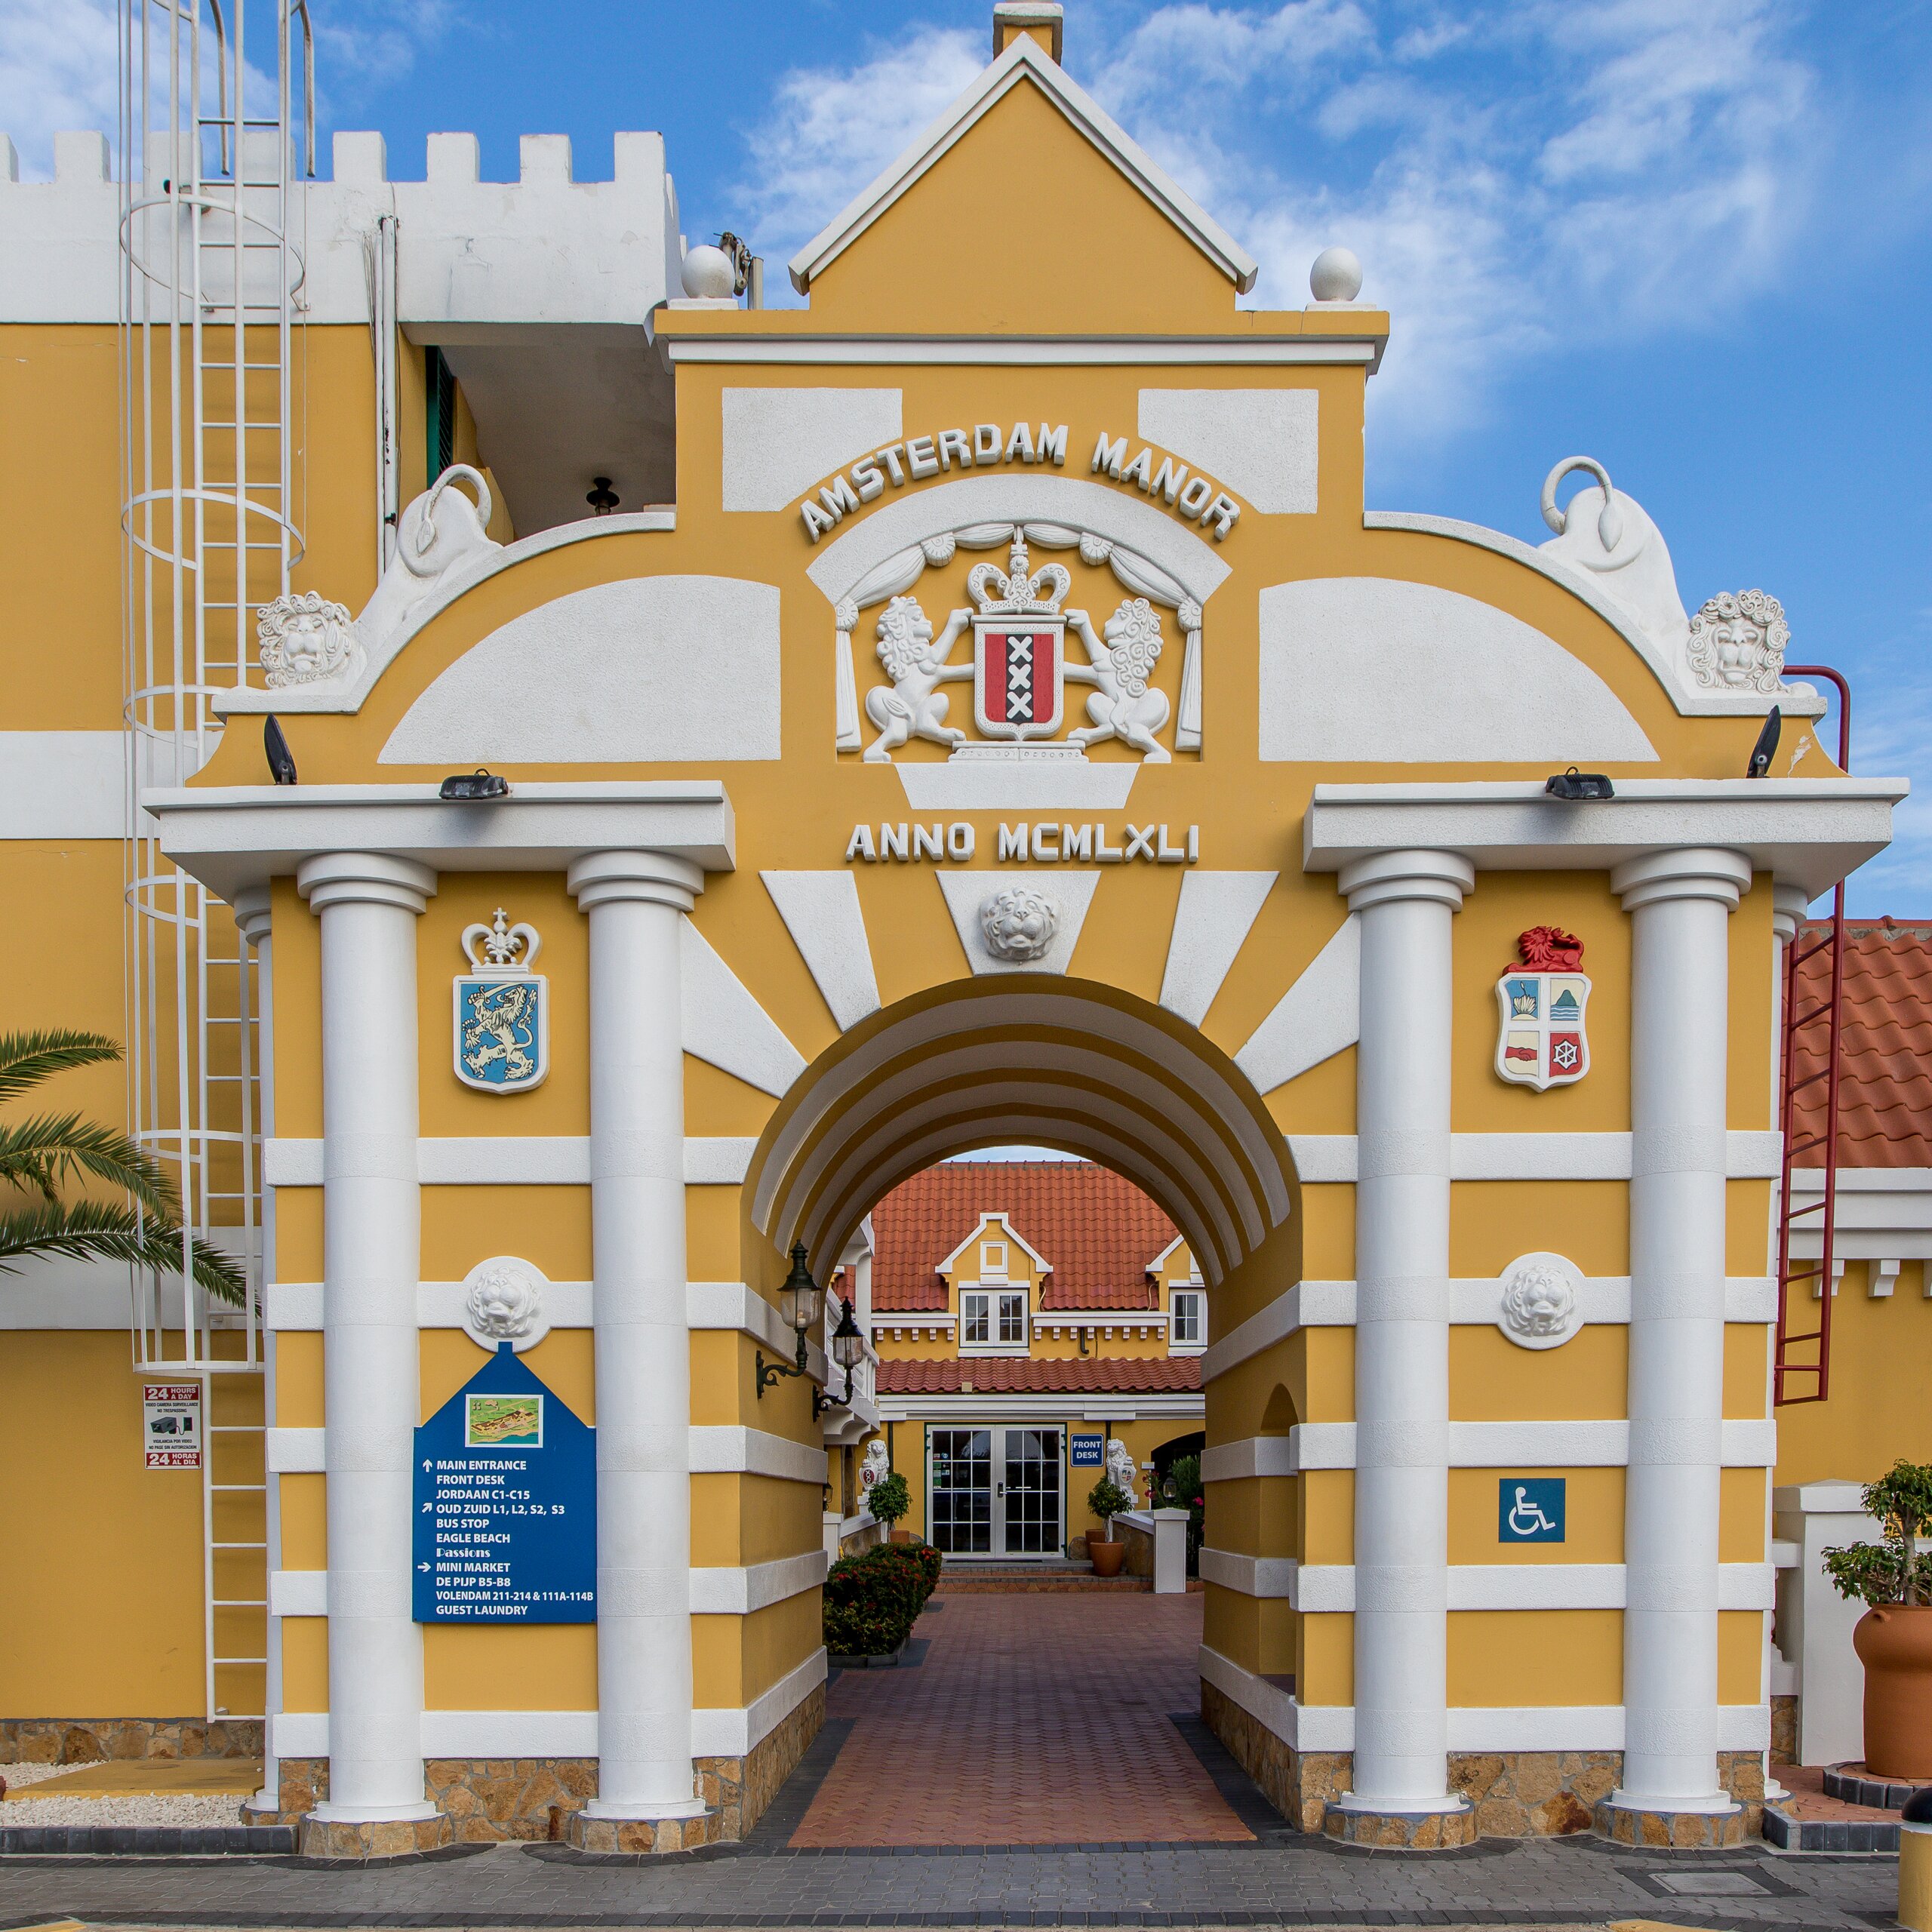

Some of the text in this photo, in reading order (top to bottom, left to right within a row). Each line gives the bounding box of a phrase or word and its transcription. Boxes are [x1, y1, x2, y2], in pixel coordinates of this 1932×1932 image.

[799, 422, 1241, 543] AMSTERDAM MANOR
[845, 822, 1199, 863] ANNO MCMLXLI
[147, 1388, 169, 1400] 24
[149, 1453, 170, 1465] 24
[436, 1460, 527, 1470] MAIN ENTRANCE
[436, 1475, 505, 1484] FRONT DESK
[436, 1490, 530, 1500] JORDAAN C1-C15
[436, 1504, 565, 1515] OUD ZUID L1, L2, S2, S3
[436, 1519, 489, 1528] BUS STOP
[436, 1534, 510, 1543] EAGLE BEACH
[436, 1548, 491, 1558] Passions
[436, 1562, 510, 1572] MINI MARKET
[436, 1577, 511, 1586] DE PIJP B5-B8
[436, 1591, 594, 1601] VOLENDAM 211-214 & 111A-114B
[436, 1605, 528, 1615] GUEST LAUNDRY
